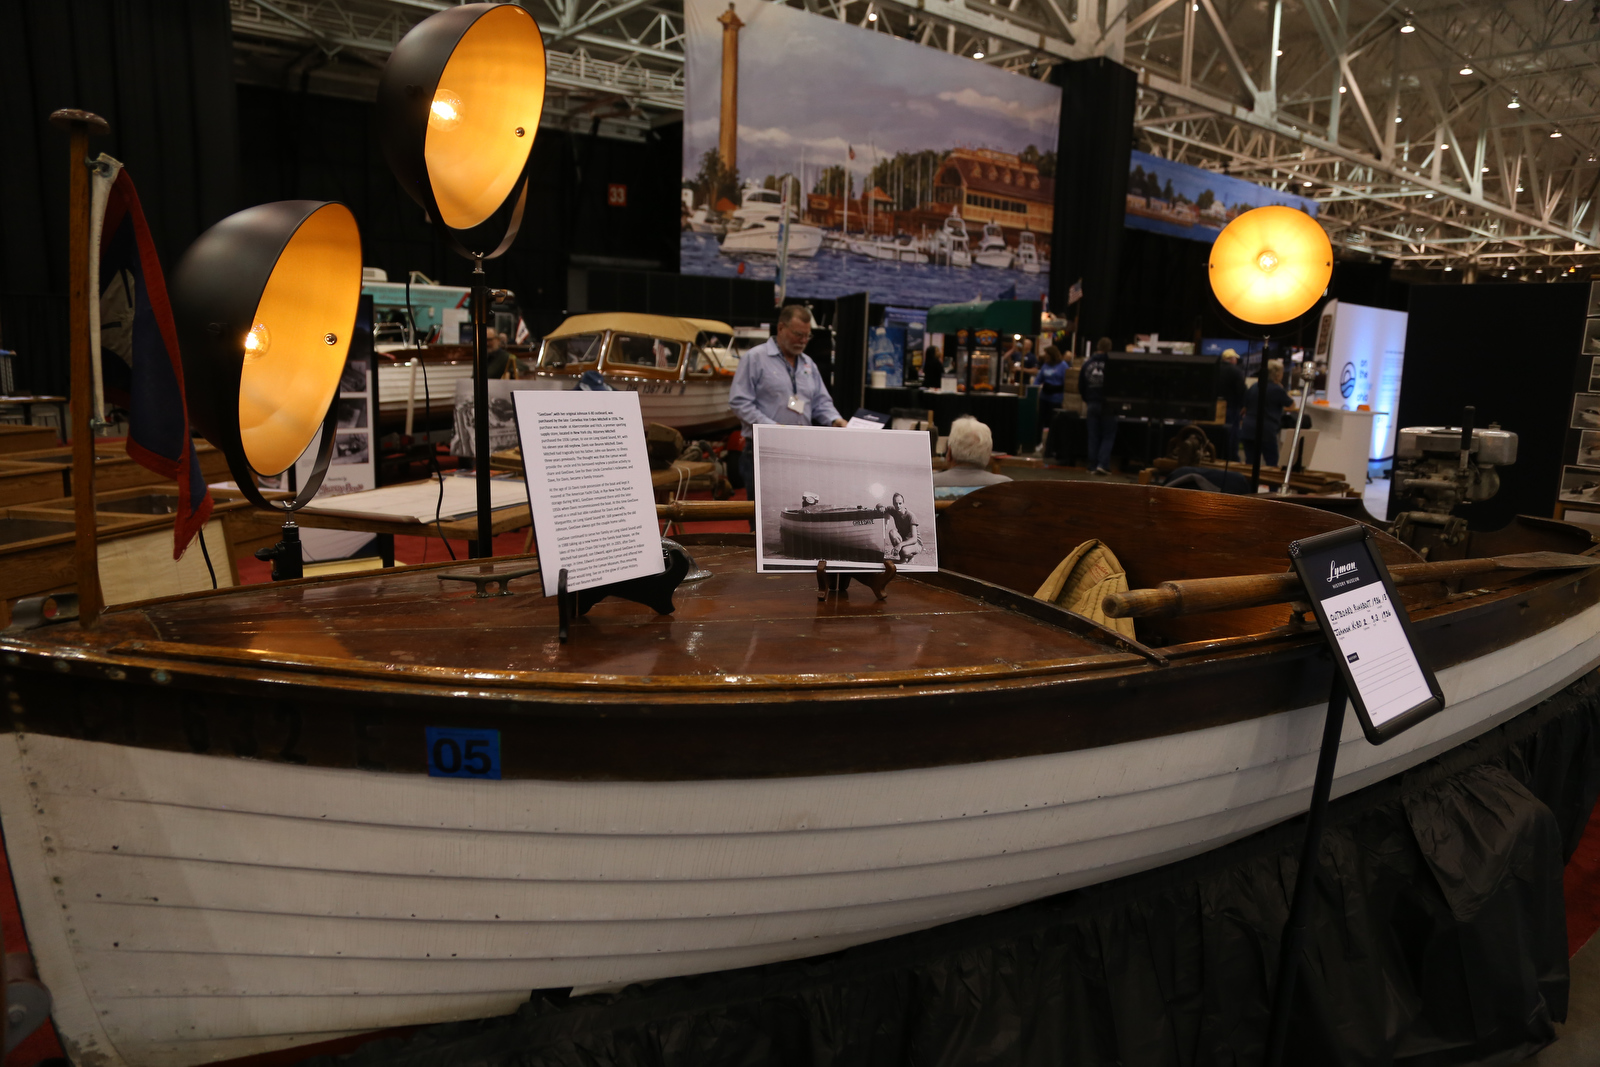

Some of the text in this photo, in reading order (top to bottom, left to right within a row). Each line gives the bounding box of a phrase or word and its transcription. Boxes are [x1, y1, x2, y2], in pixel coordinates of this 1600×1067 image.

[610, 187, 625, 203] 33
[1326, 560, 1359, 583] Lyman
[1332, 577, 1360, 589] HISTORY MUSEUM
[433, 738, 491, 775] 05
